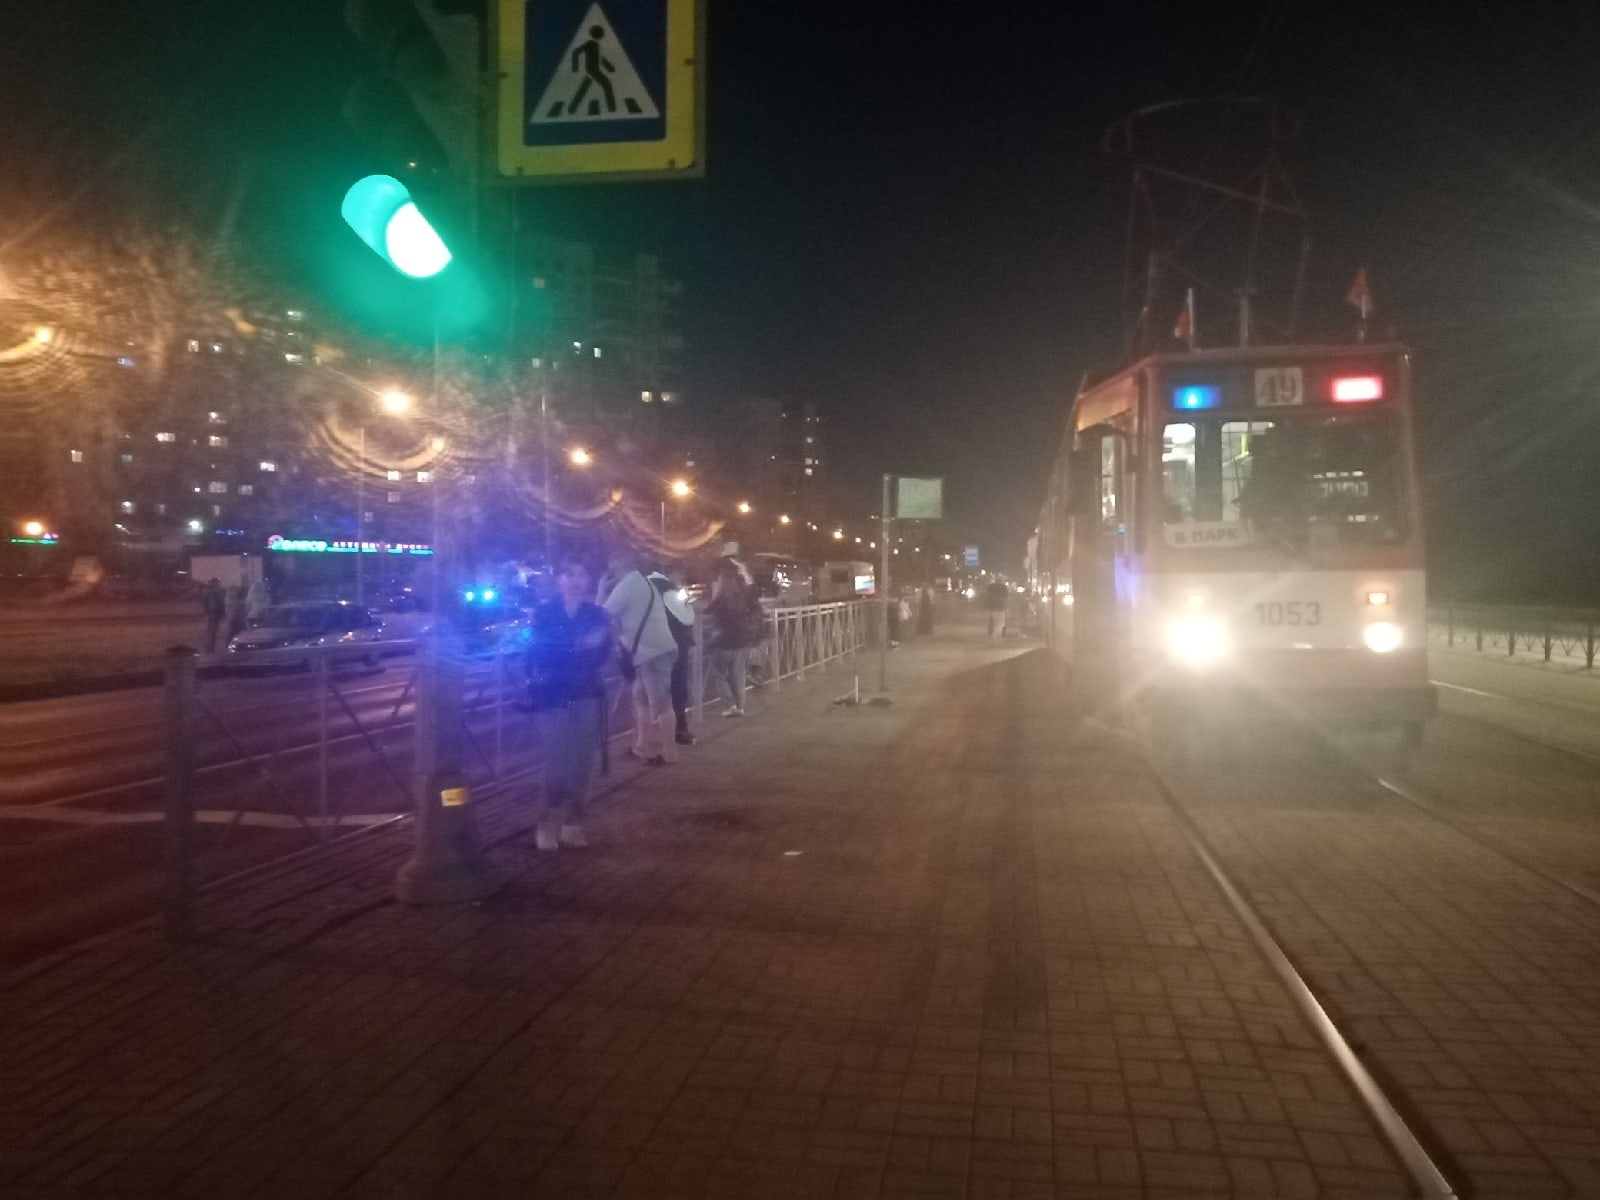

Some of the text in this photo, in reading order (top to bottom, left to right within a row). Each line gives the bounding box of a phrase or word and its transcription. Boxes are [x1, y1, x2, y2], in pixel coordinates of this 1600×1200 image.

[1258, 374, 1297, 404] 49
[1191, 527, 1240, 542] ПАРК
[1254, 601, 1323, 627] 1053
